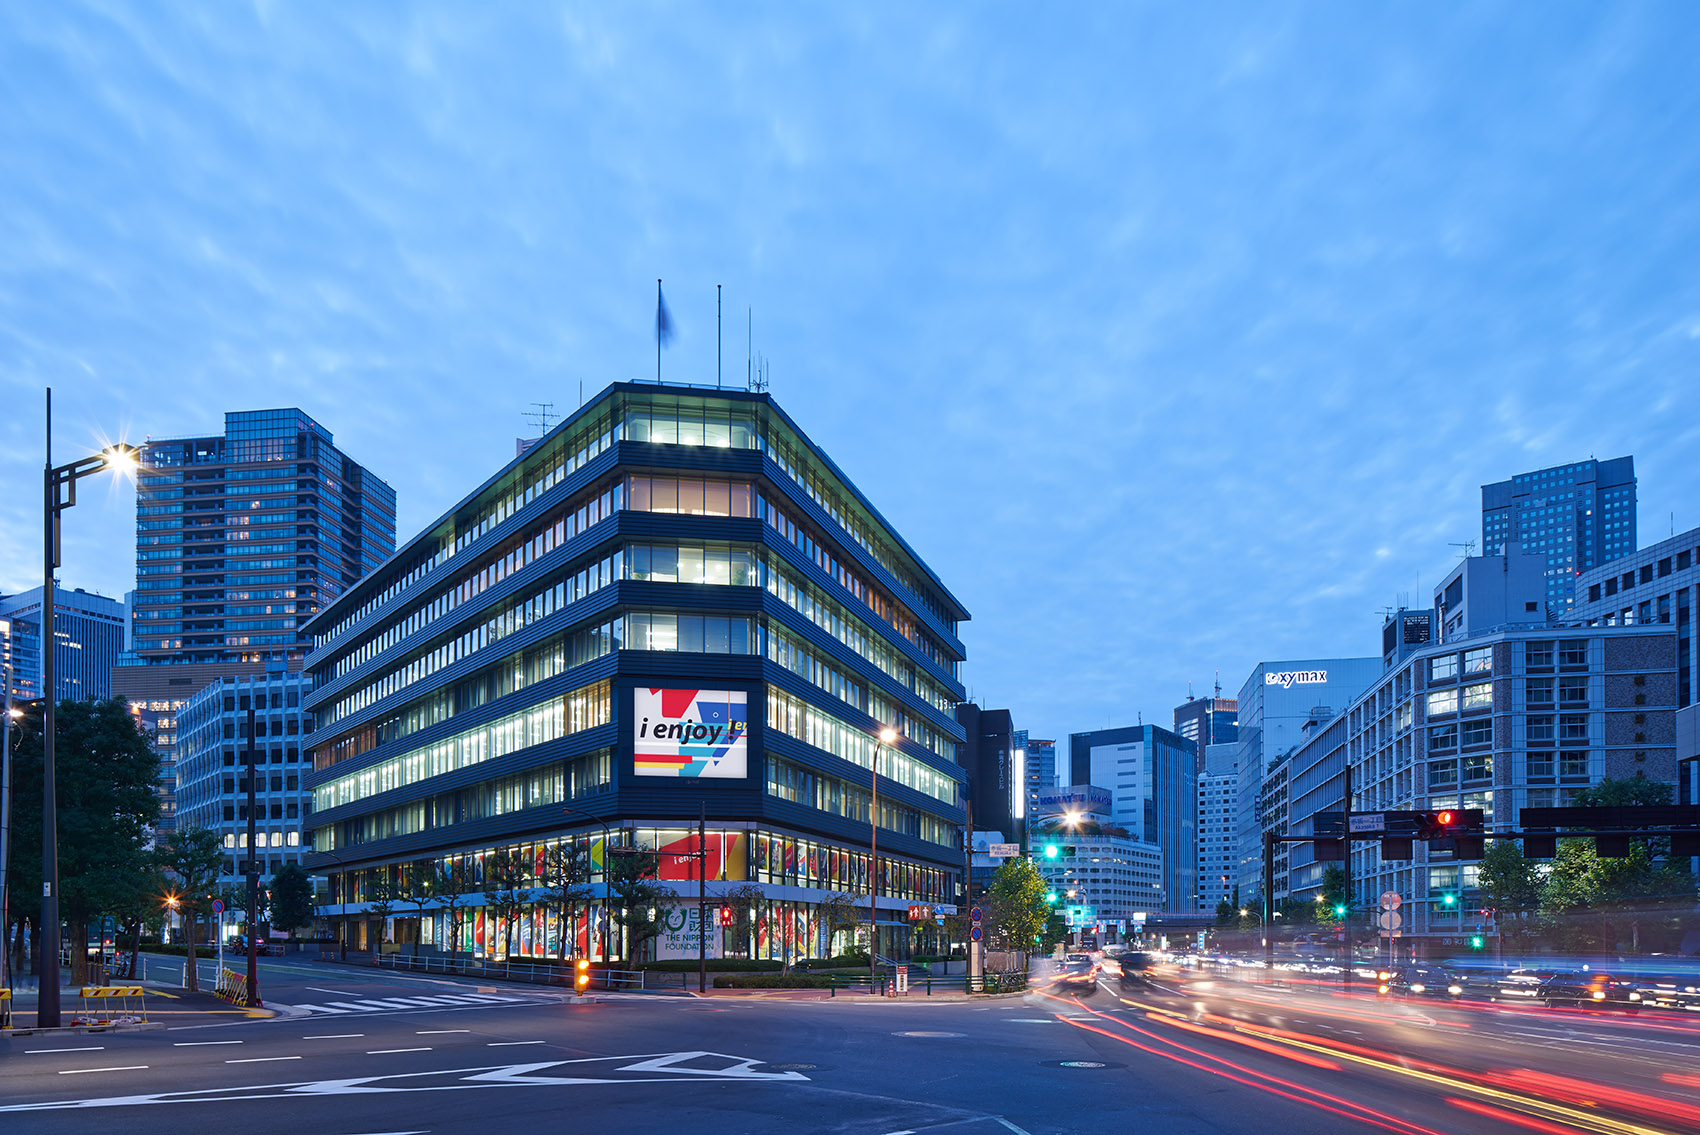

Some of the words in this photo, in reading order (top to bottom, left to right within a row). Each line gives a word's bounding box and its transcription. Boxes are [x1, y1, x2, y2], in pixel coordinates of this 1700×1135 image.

[640, 717, 649, 738] i
[653, 719, 723, 746] enjoy
[1040, 793, 1085, 805] KOMATSU
